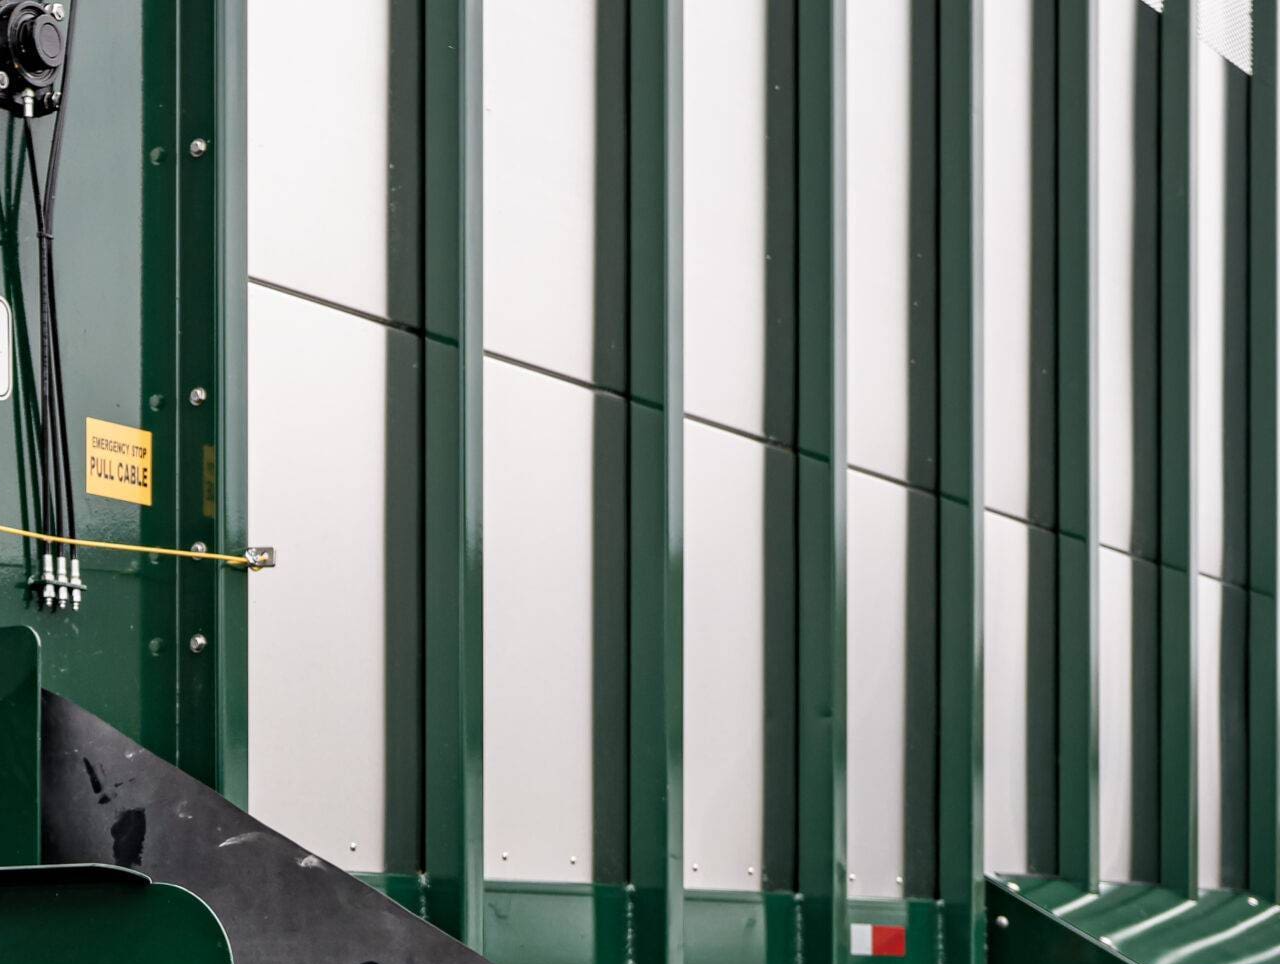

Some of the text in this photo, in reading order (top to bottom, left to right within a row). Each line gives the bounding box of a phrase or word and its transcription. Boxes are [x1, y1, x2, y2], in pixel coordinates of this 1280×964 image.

[92, 436, 147, 459] EMERGENCY STOP
[90, 457, 148, 487] PULL CABLE
